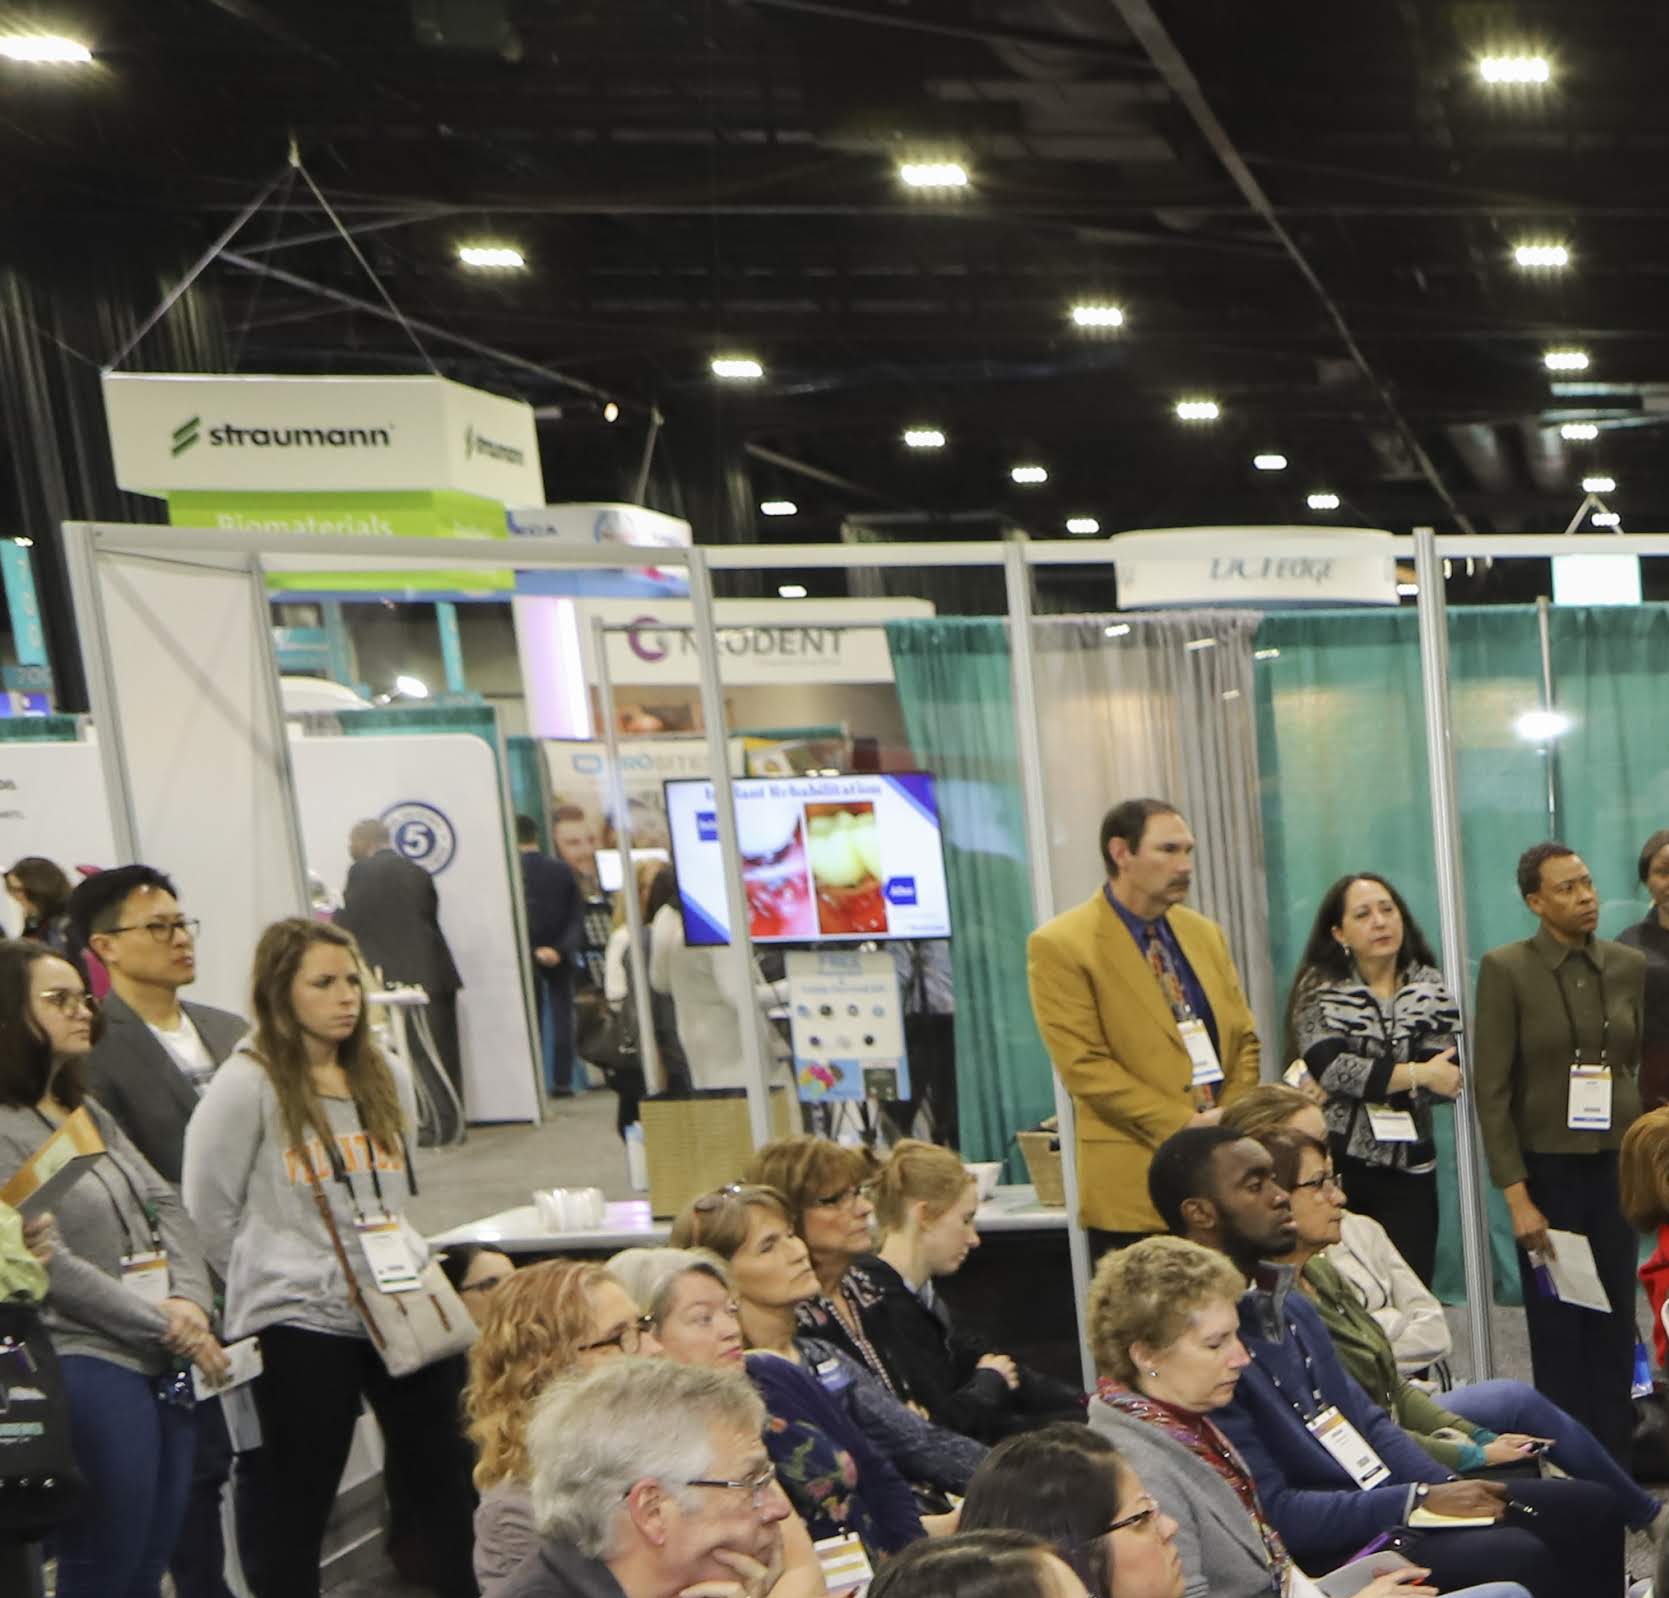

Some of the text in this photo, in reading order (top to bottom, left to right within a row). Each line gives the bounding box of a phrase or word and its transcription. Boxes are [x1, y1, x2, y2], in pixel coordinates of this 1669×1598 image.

[208, 422, 391, 448] straumann
[680, 624, 845, 656] NODENT
[404, 825, 429, 856] 5
